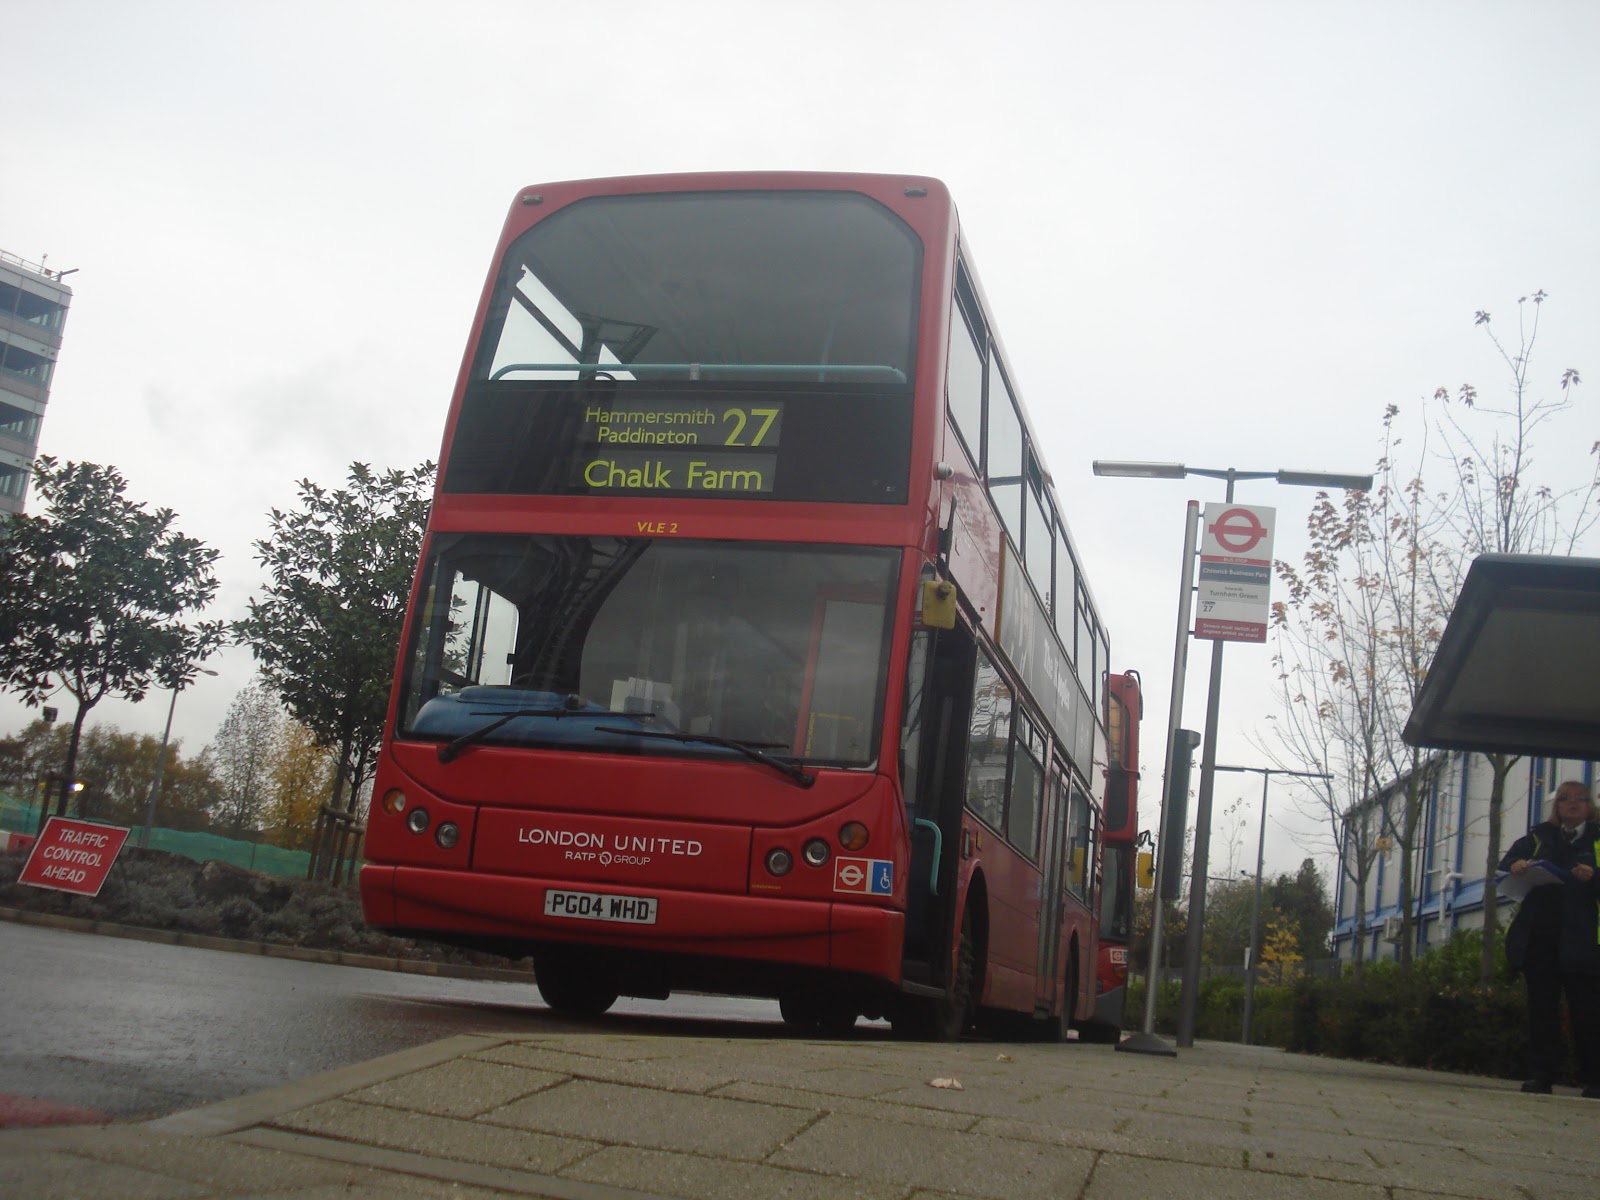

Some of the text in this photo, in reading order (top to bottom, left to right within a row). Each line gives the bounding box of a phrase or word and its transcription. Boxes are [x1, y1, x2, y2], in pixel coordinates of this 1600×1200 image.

[585, 407, 715, 425] Hammersmith
[598, 426, 697, 444] Paddington
[723, 408, 779, 446] 27
[584, 460, 762, 490] Chalk Farm
[637, 521, 678, 534] VLE 2
[1210, 590, 1237, 598] Turnham
[1203, 605, 1214, 613] 27
[1043, 637, 1054, 680] The
[59, 829, 109, 848] TRAFFIC
[518, 828, 703, 856] LONDON UNITED
[43, 845, 102, 867] CONTROL
[565, 850, 651, 866] RATP GROUP
[41, 865, 86, 883] AHEAD
[551, 893, 650, 921] PG04 WHD
